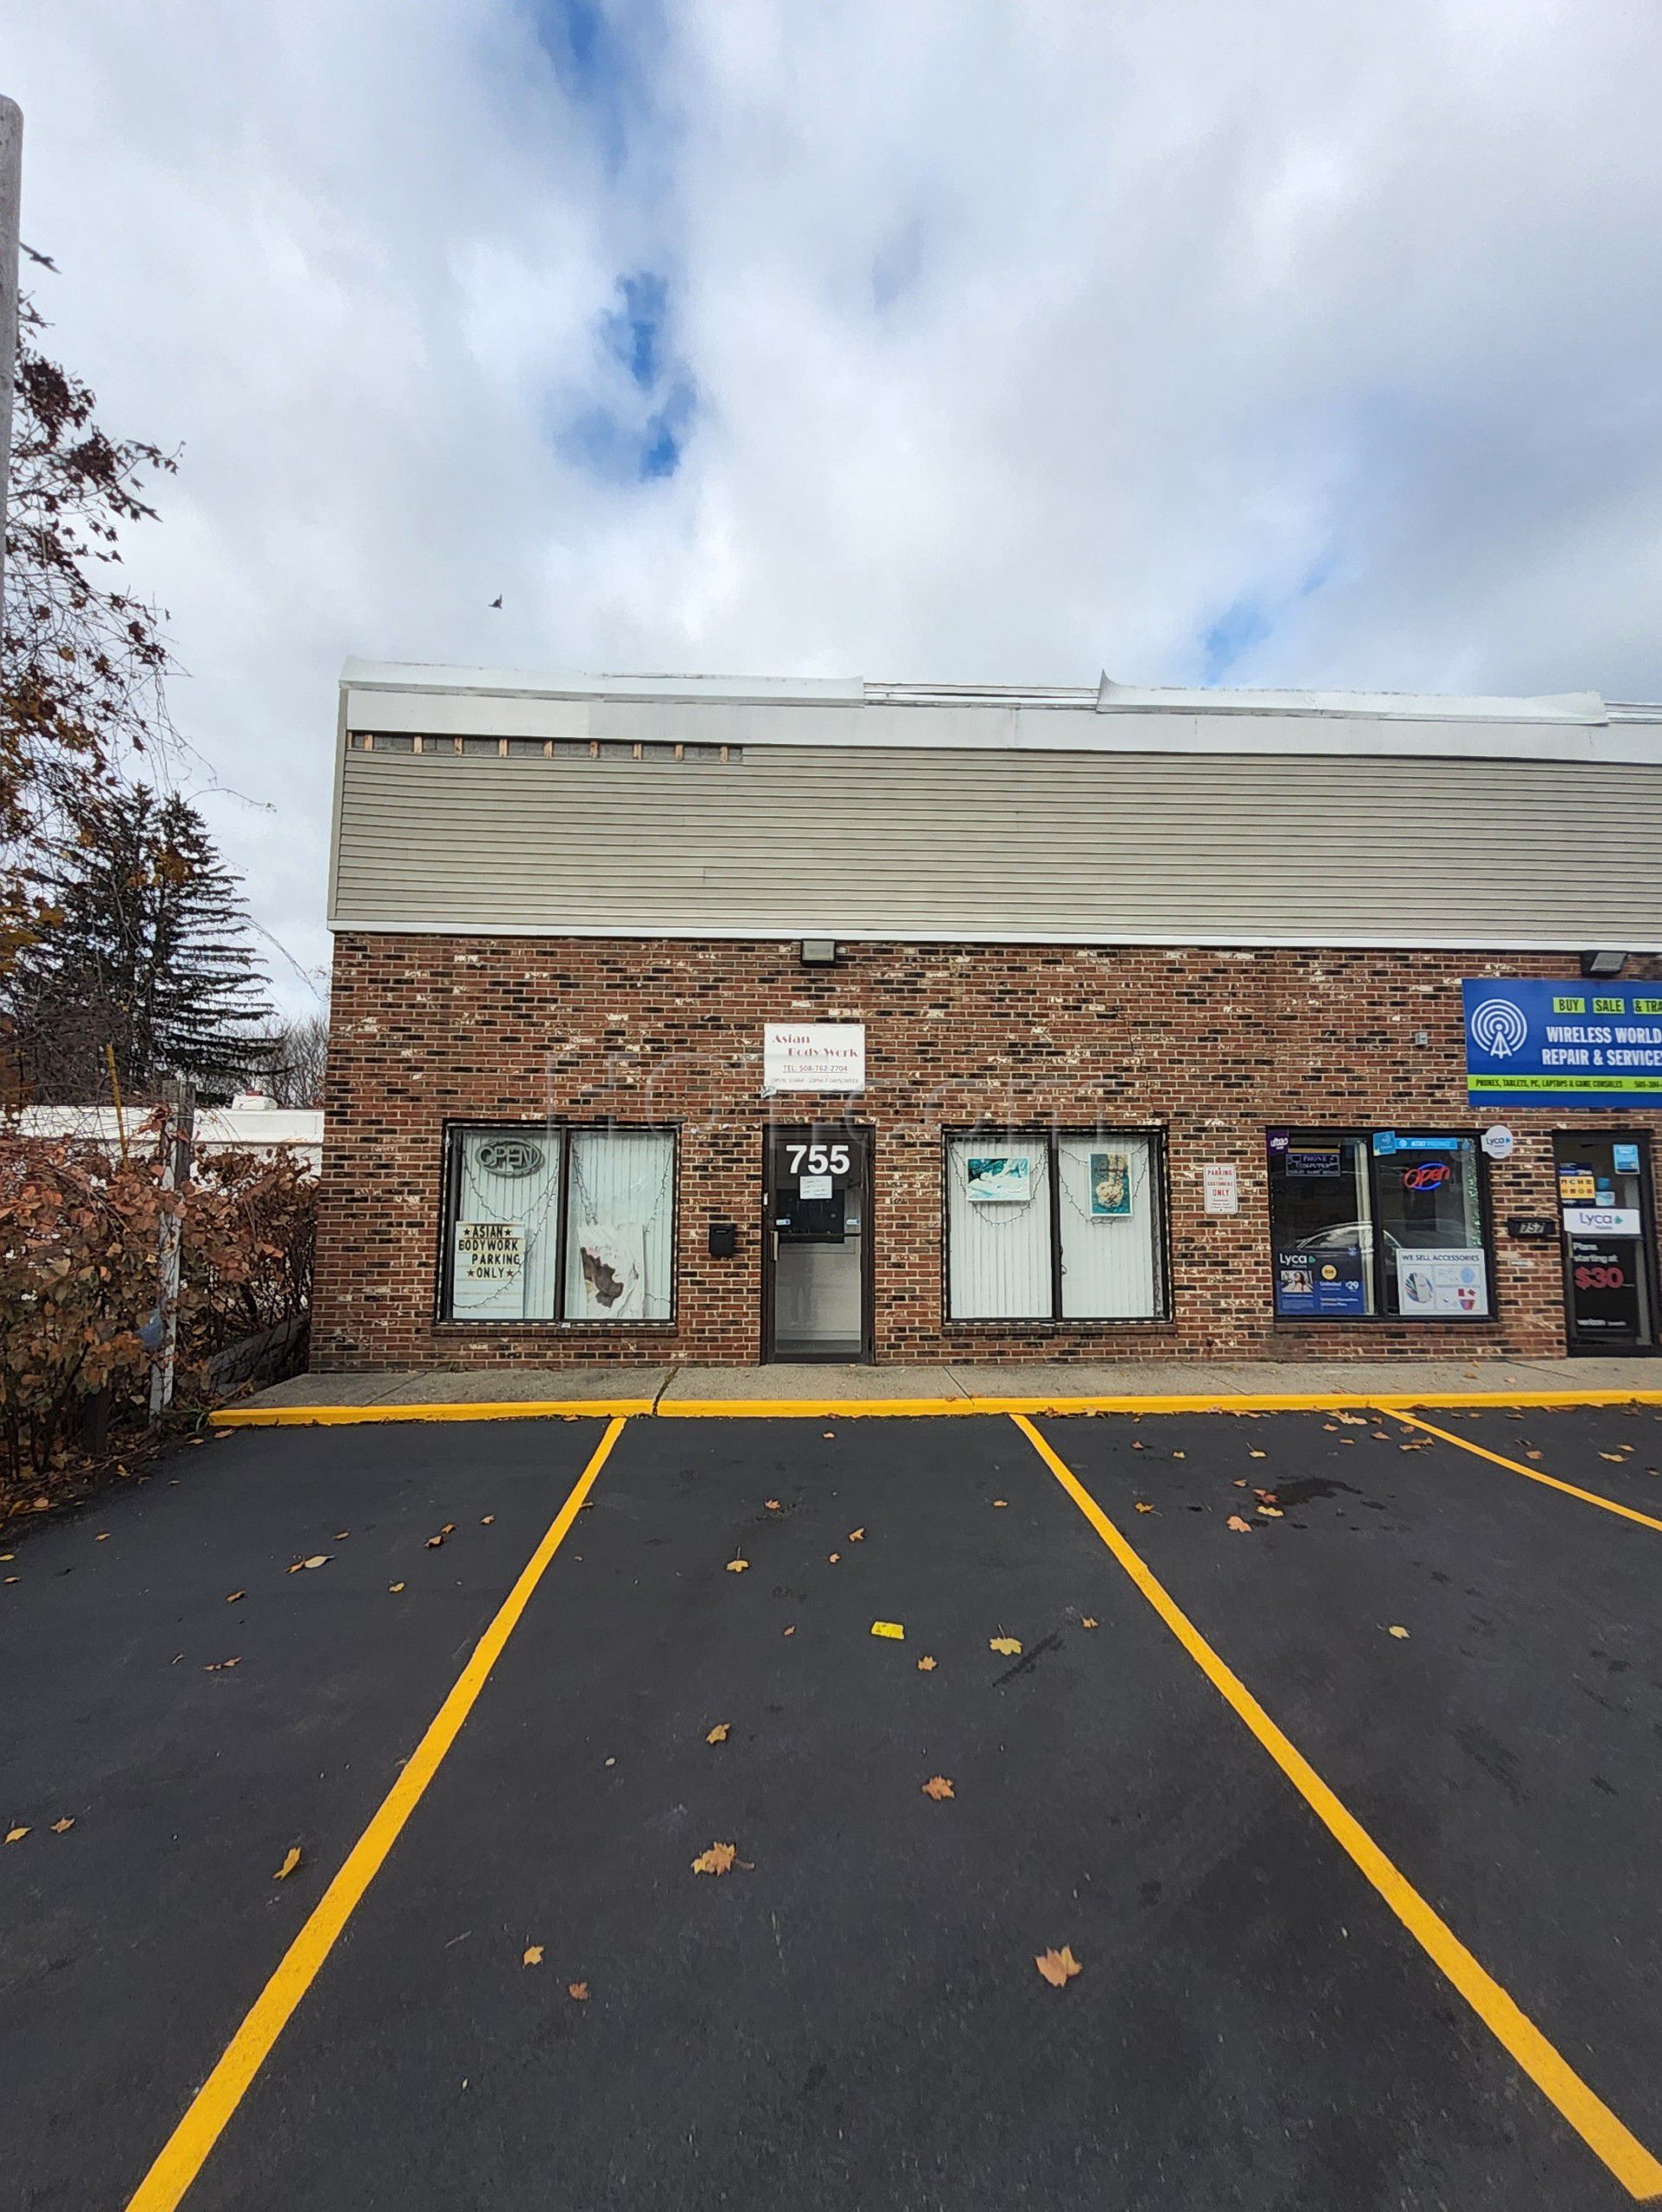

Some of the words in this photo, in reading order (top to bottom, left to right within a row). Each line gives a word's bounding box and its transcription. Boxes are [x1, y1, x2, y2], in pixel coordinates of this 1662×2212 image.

[1558, 999, 1579, 1012] BUY
[1595, 999, 1623, 1013] SALE
[1635, 1000, 1643, 1013] &
[772, 1034, 811, 1044] Asian
[1546, 1026, 1612, 1044] WIRELESS
[1614, 1027, 1662, 1045] WORLD
[787, 1047, 819, 1058] Body
[824, 1047, 858, 1058] Work
[1542, 1048, 1590, 1065] REPAIR
[1593, 1049, 1604, 1066] &
[1607, 1049, 1662, 1067] SERVICE
[1486, 1136, 1505, 1147] Lyca
[480, 1145, 534, 1166] OPEN
[786, 1144, 850, 1174] 755
[1403, 1166, 1451, 1189] Open
[1212, 1188, 1230, 1197] ONLY
[1579, 1211, 1613, 1226] Lyca
[472, 1225, 503, 1238] ASIAN
[1522, 1222, 1543, 1233] 757
[458, 1239, 519, 1251] BODYWORK
[471, 1253, 520, 1265] PARKING
[1279, 1253, 1308, 1266] Lyca
[476, 1266, 505, 1279] ONLY
[1575, 1266, 1624, 1290] $30
